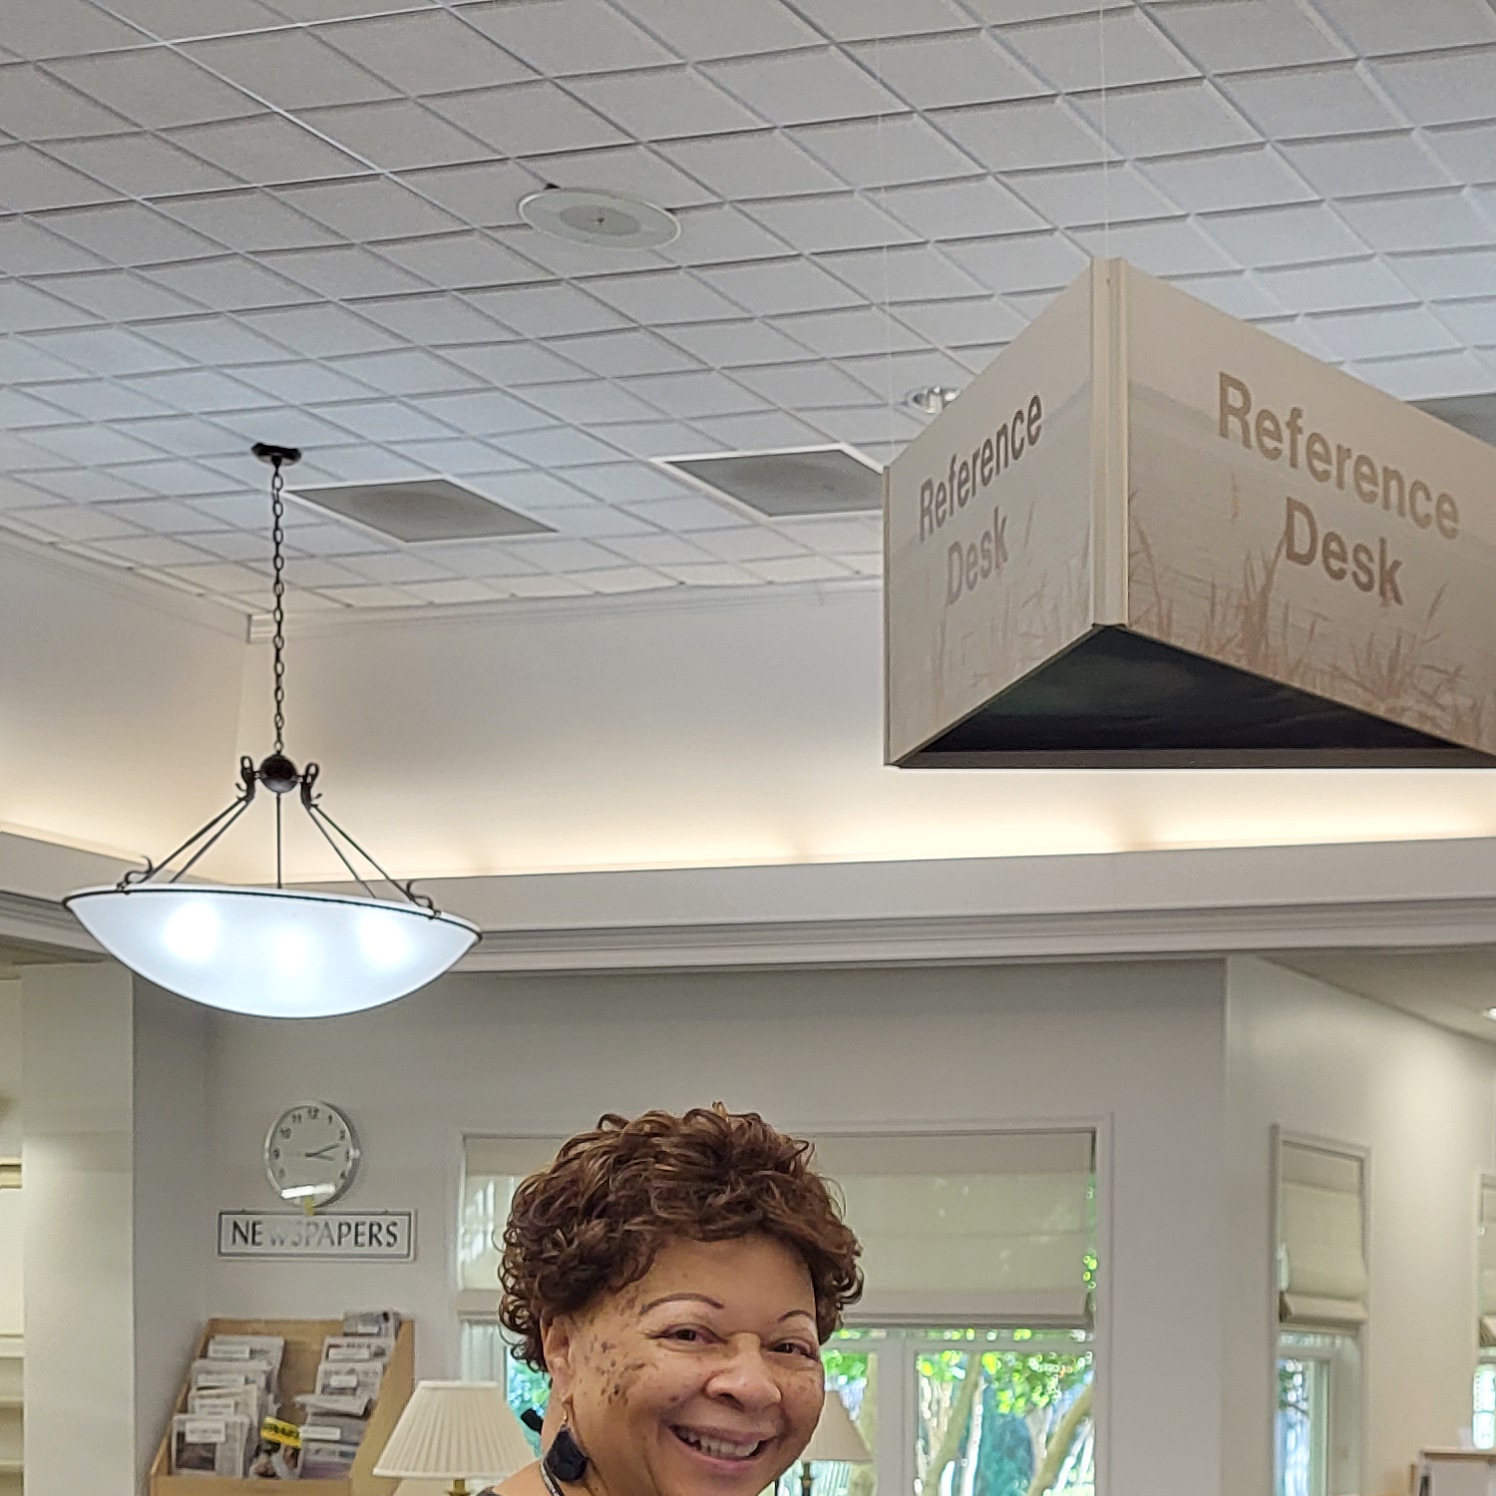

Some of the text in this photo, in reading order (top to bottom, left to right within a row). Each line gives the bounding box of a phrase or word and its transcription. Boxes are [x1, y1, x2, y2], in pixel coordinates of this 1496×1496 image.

[918, 394, 1043, 543] Reference
[1217, 370, 1461, 541] Reference
[945, 505, 1010, 605] Desk
[1283, 496, 1404, 606] Desk
[307, 1108, 320, 1119] 12
[231, 1220, 398, 1248] NEWSPAPERS
